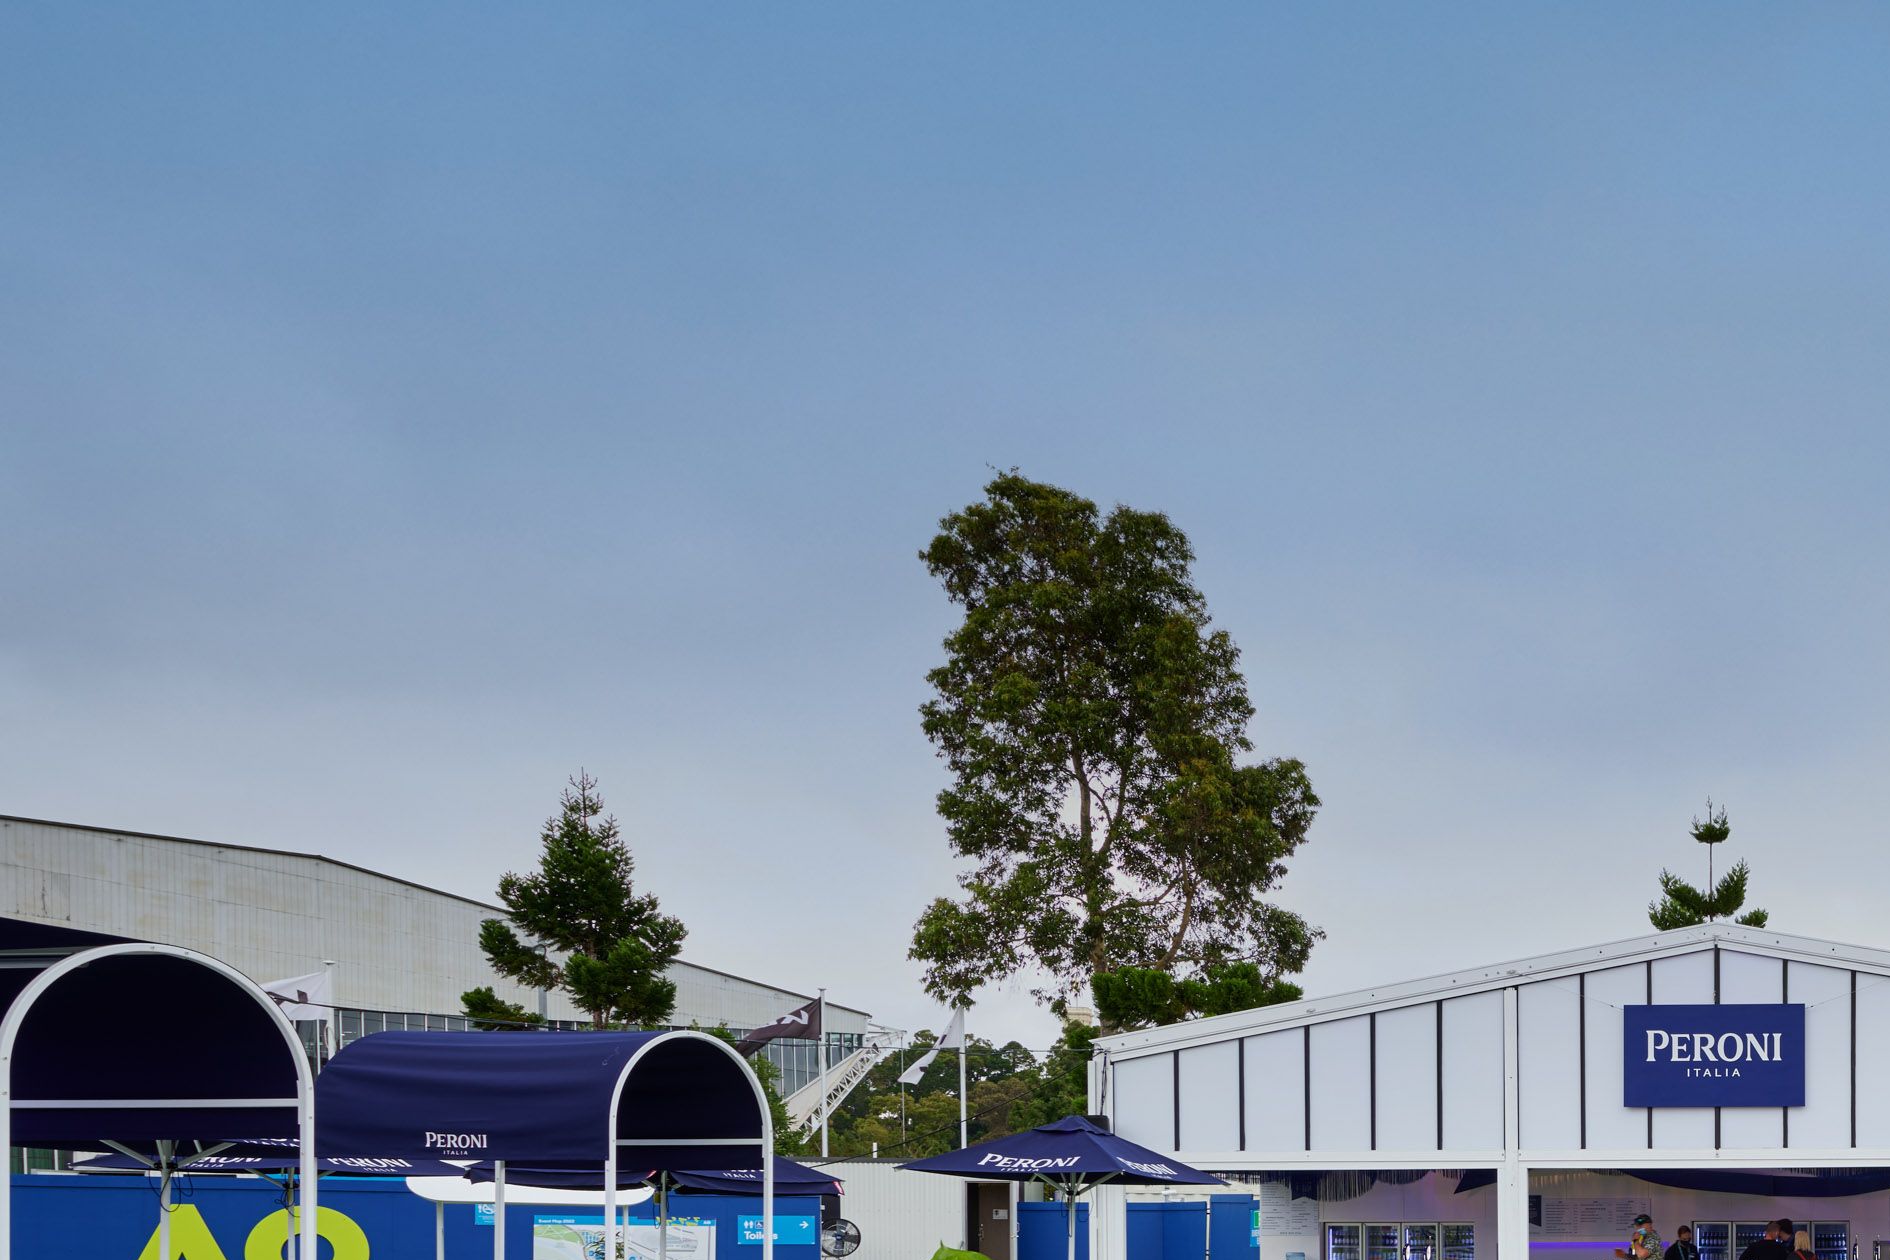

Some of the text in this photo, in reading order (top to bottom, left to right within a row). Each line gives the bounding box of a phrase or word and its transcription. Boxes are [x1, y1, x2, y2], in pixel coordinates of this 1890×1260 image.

[1646, 1030, 1782, 1062] PERONI
[1687, 1068, 1741, 1077] ITALIA
[425, 1131, 487, 1148] PERONI
[977, 1153, 1081, 1169] PERONI
